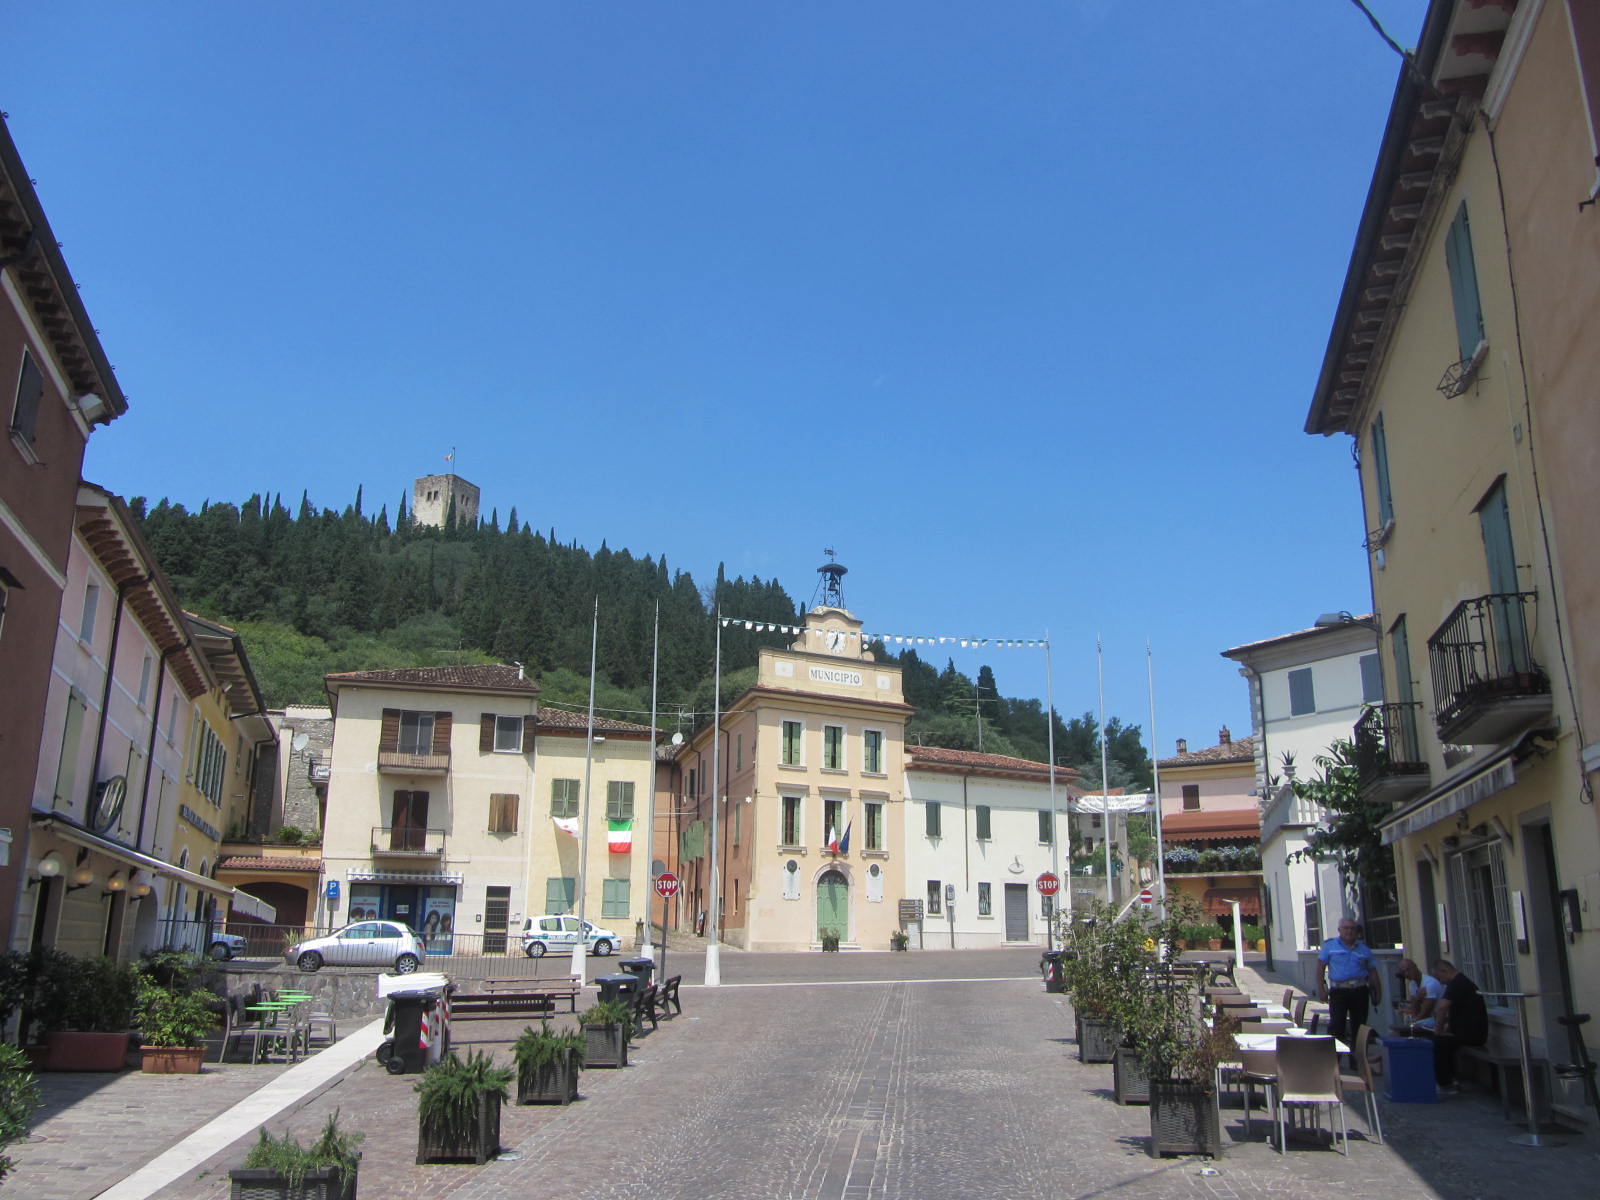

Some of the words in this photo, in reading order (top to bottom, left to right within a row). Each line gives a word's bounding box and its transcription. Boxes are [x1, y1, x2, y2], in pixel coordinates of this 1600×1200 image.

[811, 669, 860, 684] MUNICIPIO
[330, 882, 336, 890] P
[657, 880, 678, 890] STOP
[1038, 881, 1058, 890] STOP
